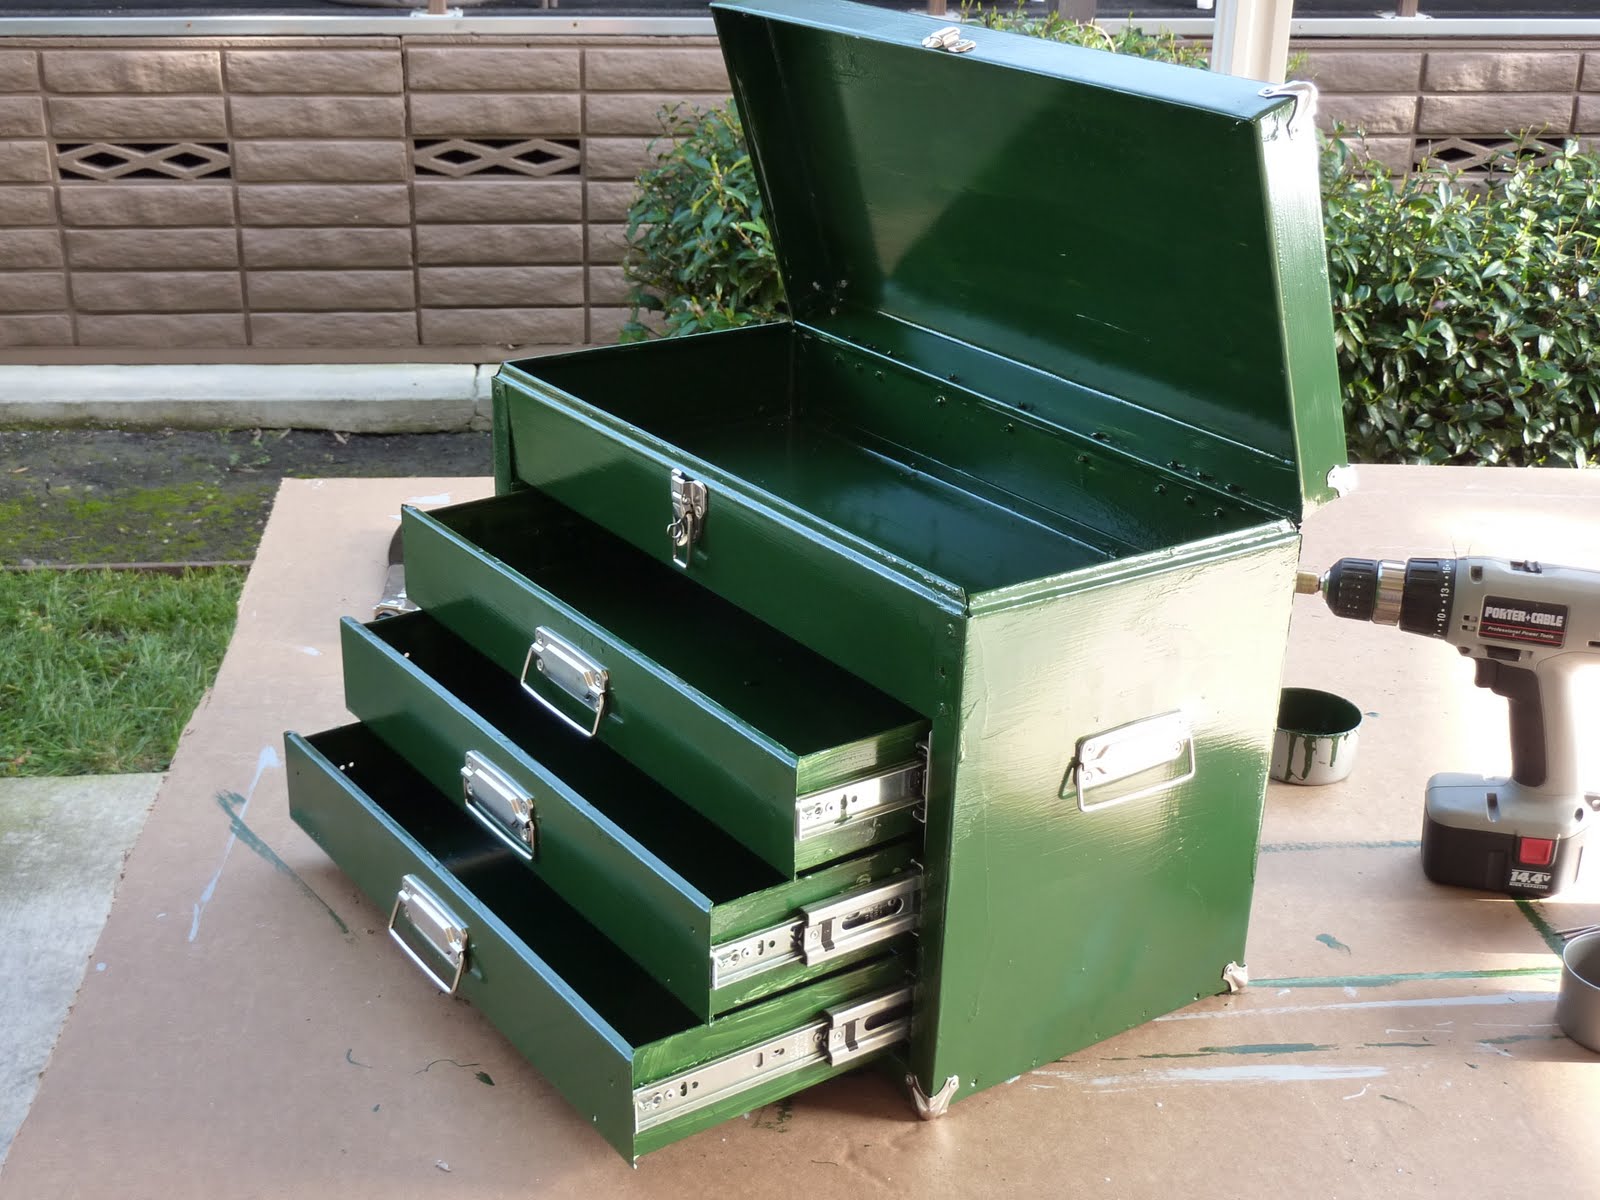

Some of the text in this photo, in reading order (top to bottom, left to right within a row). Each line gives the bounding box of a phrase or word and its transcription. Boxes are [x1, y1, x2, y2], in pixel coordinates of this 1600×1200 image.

[1442, 566, 1451, 574] 16
[1440, 588, 1449, 597] 13
[1436, 613, 1446, 622] 10
[1487, 626, 1521, 634] Professional
